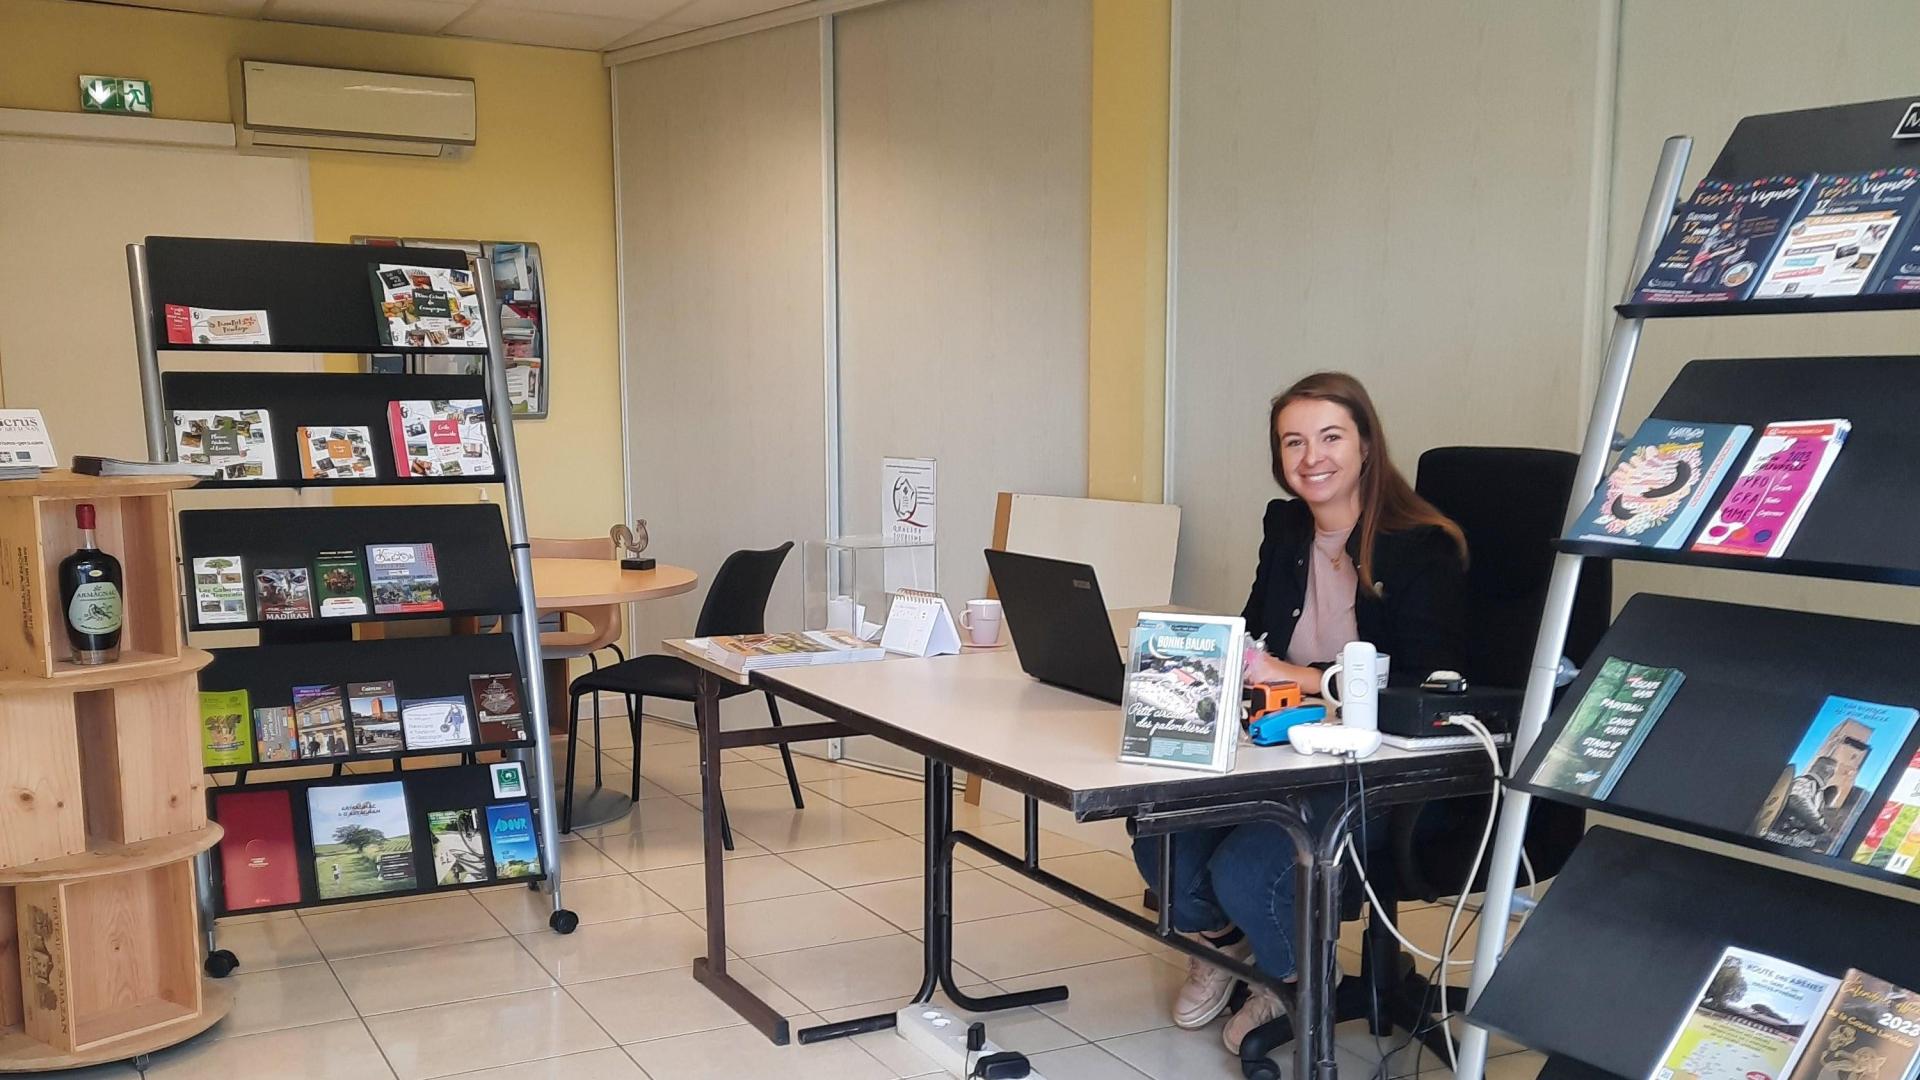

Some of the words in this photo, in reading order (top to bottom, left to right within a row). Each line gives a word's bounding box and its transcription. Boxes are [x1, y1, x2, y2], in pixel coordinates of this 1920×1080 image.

[1157, 635, 1184, 648] BONNE
[1185, 638, 1217, 651] BALADE
[1136, 717, 1151, 728] des
[495, 818, 527, 832] ADOUR
